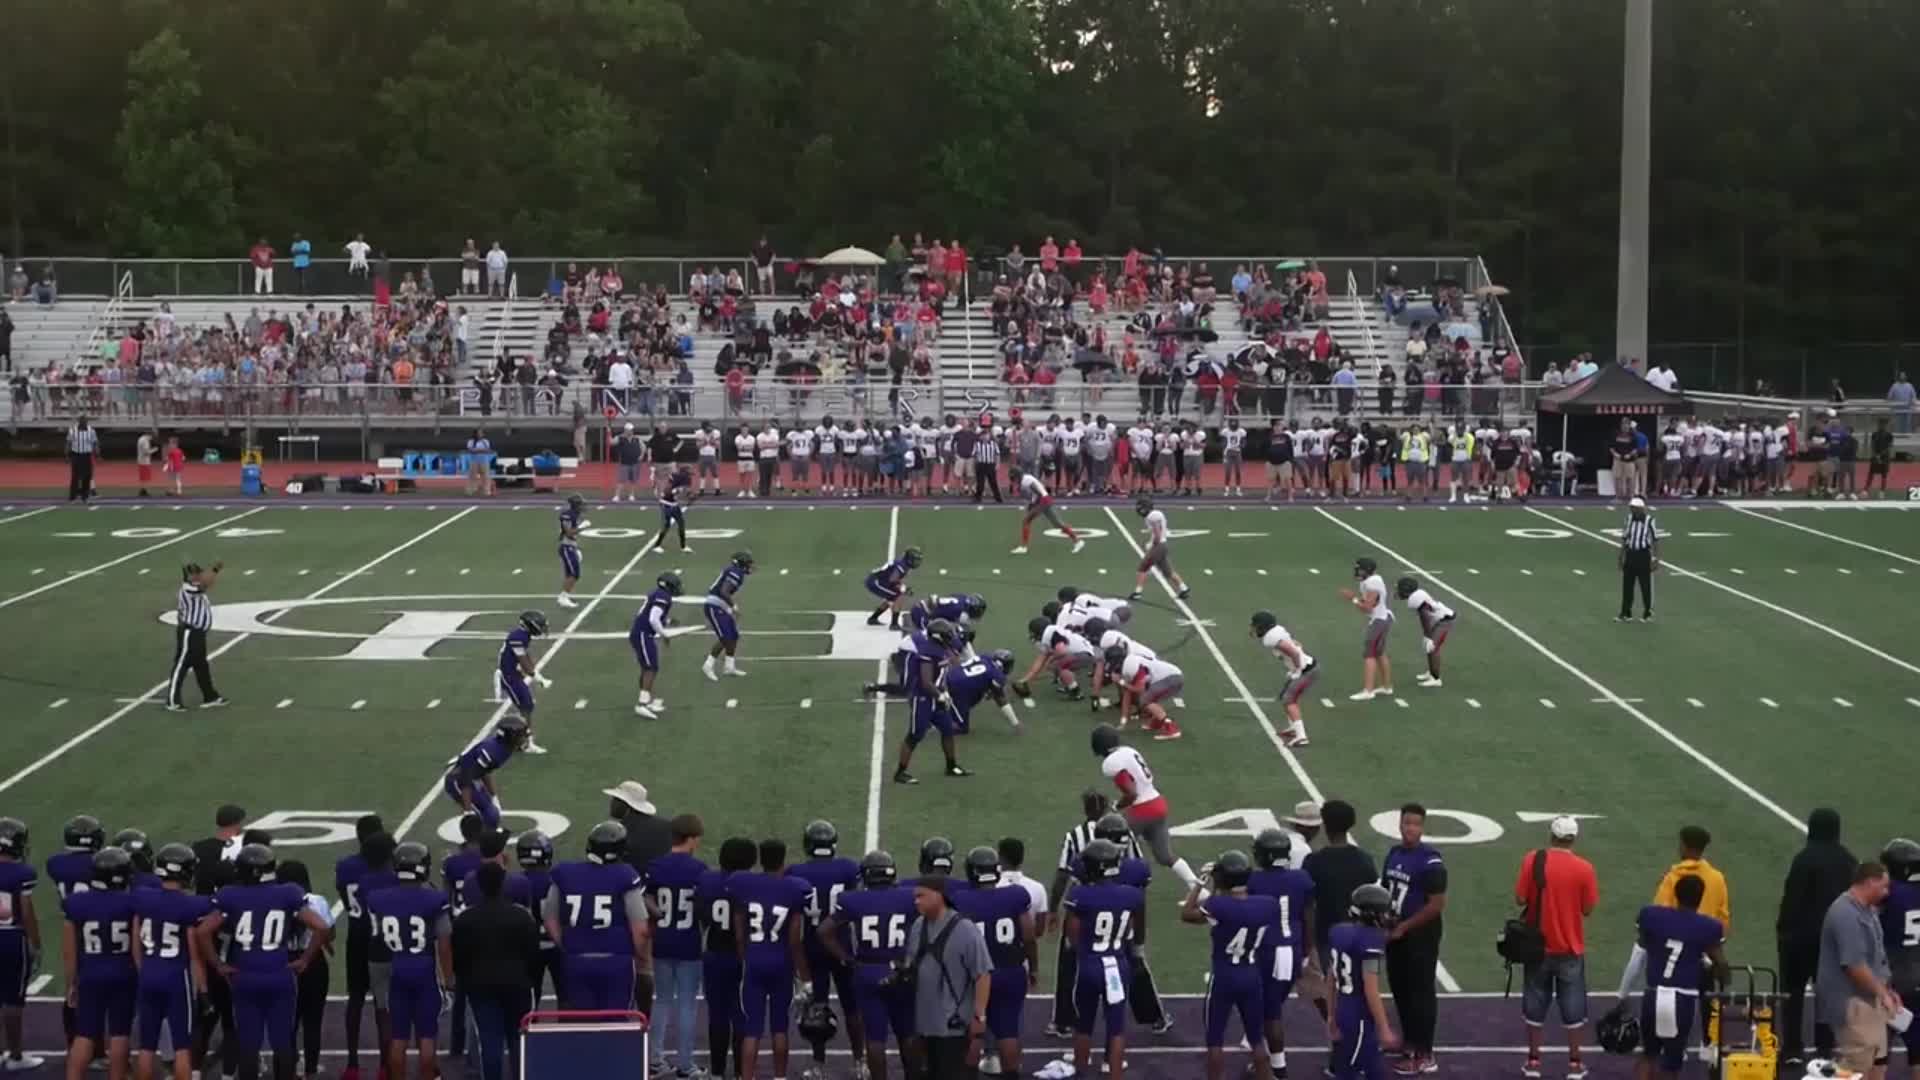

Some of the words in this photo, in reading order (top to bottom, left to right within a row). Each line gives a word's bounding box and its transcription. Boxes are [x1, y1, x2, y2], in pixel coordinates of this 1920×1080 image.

[1908, 486, 1920, 500] 2
[566, 894, 612, 929] 75
[657, 886, 694, 930] 95
[747, 902, 789, 943] 37
[1279, 895, 1292, 938] 1
[82, 921, 129, 955] 65
[139, 917, 180, 958] 45
[234, 909, 286, 952] 40
[381, 915, 426, 954] 83
[861, 913, 906, 949] 56
[1092, 909, 1131, 952] 91
[1225, 927, 1267, 965] 41
[1663, 938, 1684, 979] 7
